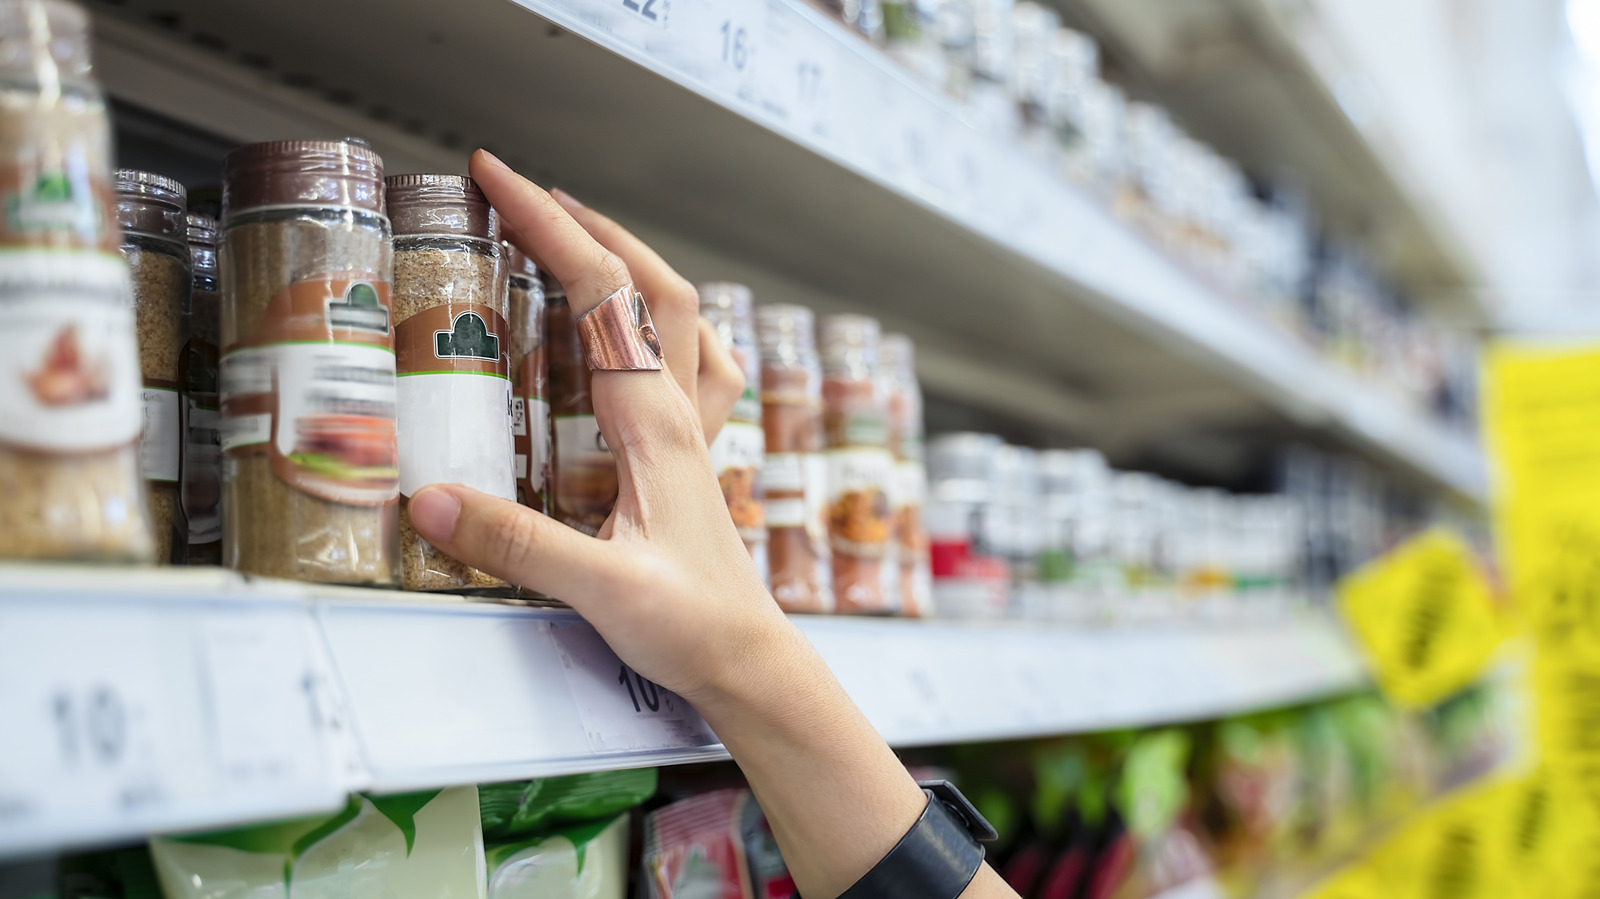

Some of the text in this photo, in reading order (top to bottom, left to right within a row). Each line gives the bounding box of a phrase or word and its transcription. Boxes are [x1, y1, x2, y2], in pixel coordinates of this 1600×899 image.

[721, 20, 748, 70] 16
[618, 665, 660, 712] 10
[50, 683, 129, 770] 10
